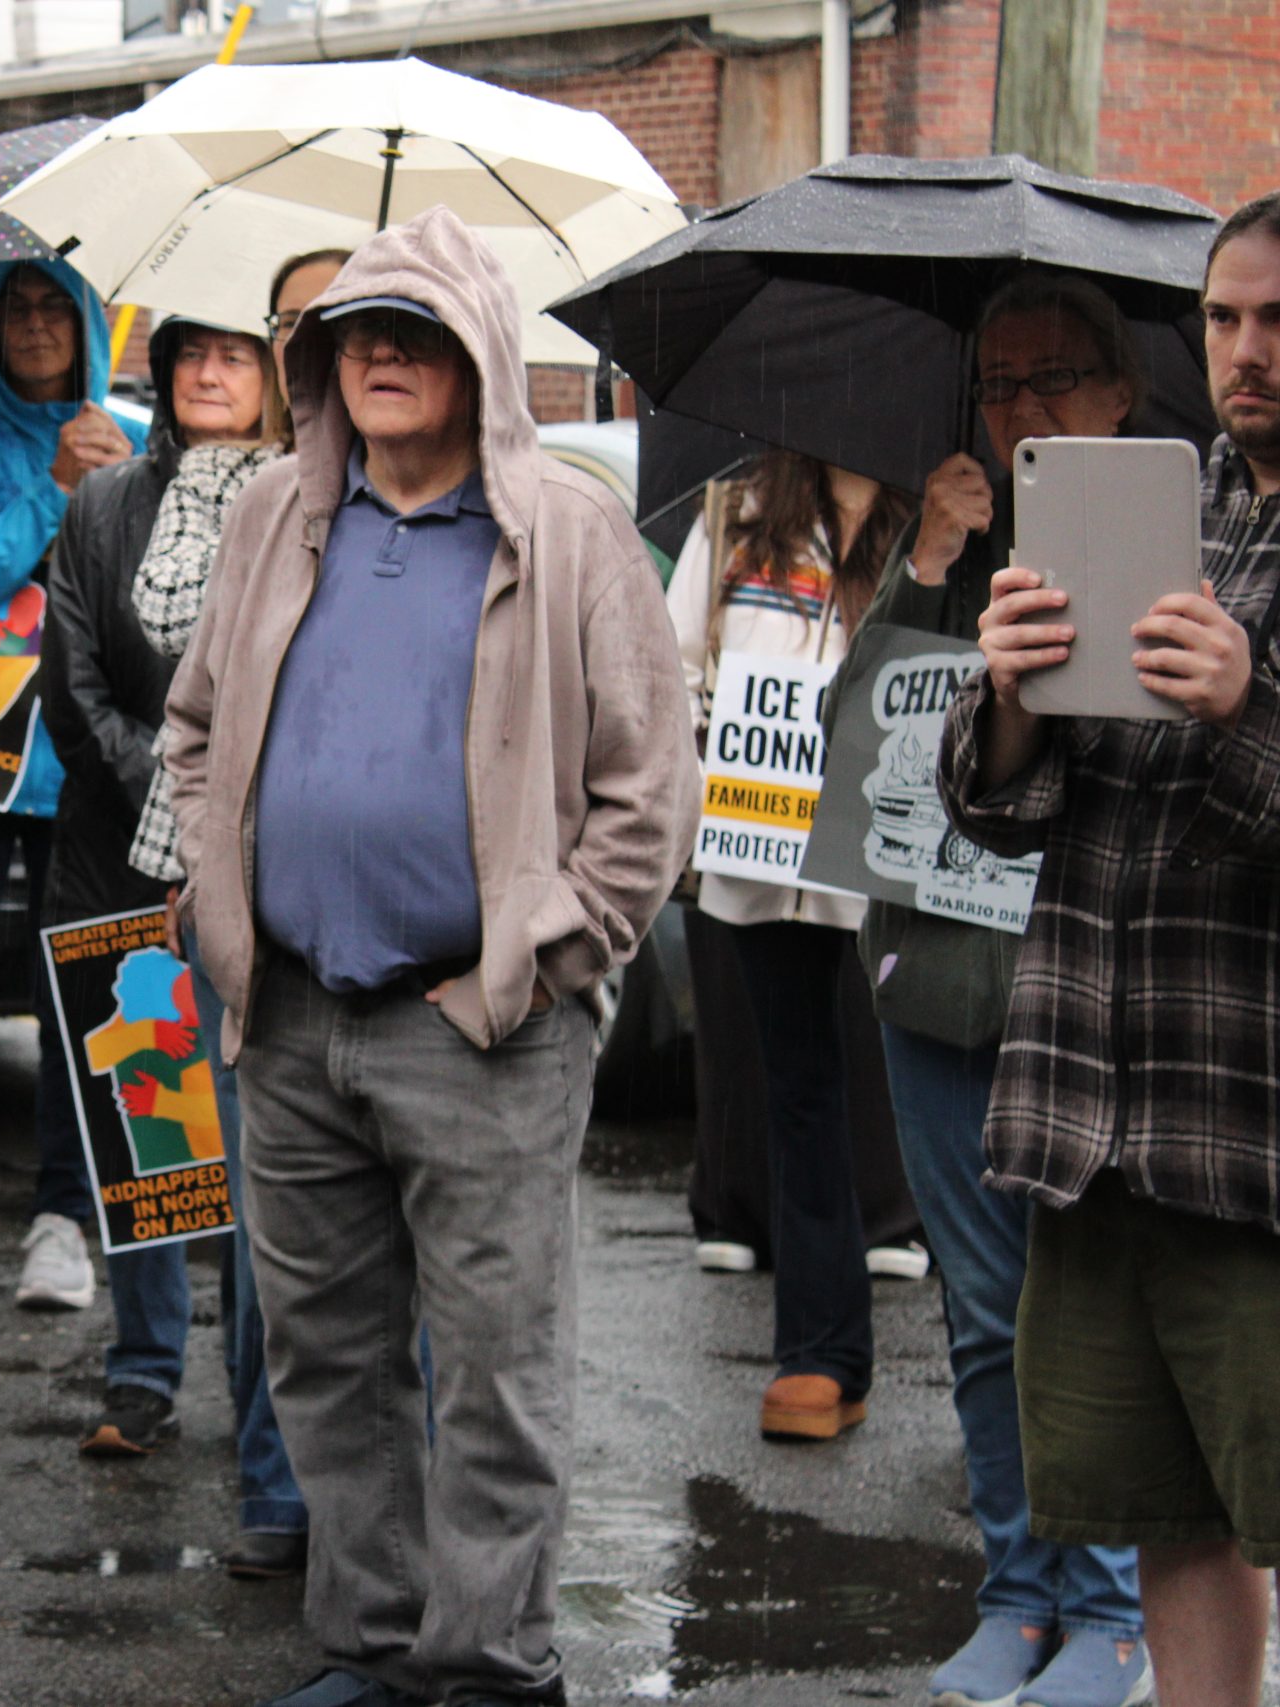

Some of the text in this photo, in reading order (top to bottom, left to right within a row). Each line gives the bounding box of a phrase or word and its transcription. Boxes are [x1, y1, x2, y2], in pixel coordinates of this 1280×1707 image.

[743, 675, 804, 721] ICE
[708, 784, 791, 817] FAMILIES
[701, 828, 802, 868] PROTECT
[51, 922, 119, 948] GREATER
[54, 940, 110, 964] UNITES
[111, 933, 141, 952] FOR
[101, 1164, 225, 1205] KIDNAPPED
[132, 1217, 167, 1240] ON
[172, 1207, 219, 1233] AUG
[133, 1199, 158, 1219] IN
